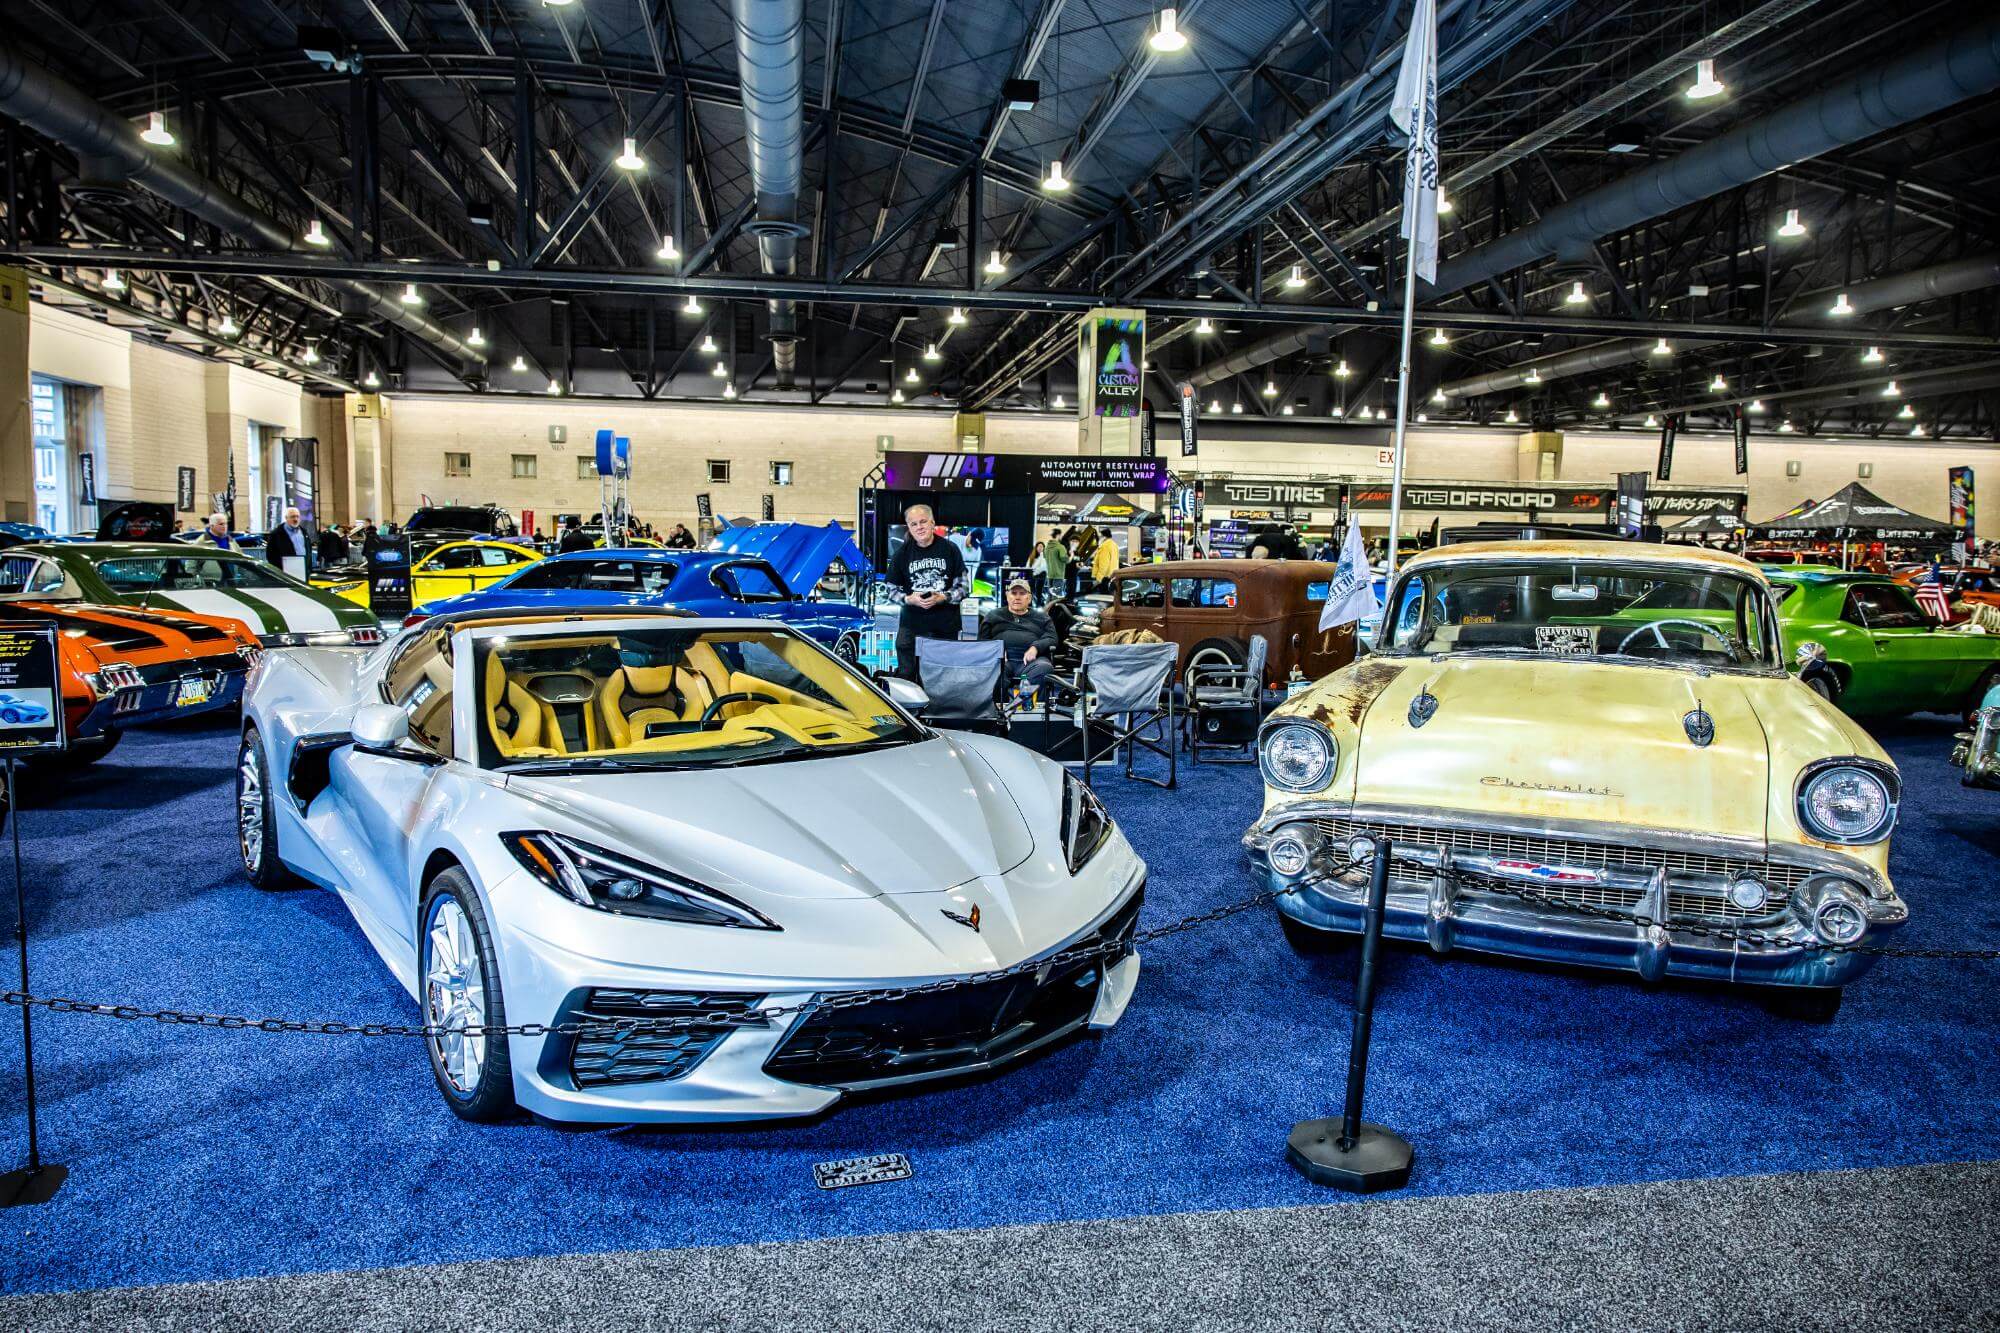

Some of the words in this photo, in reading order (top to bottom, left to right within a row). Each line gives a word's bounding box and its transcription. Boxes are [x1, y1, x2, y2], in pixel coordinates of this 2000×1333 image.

[1098, 373, 1139, 385] CUSTOM
[1098, 386, 1139, 396] ALLEY
[1379, 451, 1394, 463] EX
[1040, 461, 1101, 470] AUTOMOTIVE
[1106, 462, 1156, 470] RESTYLING
[1042, 471, 1078, 479] WINDOW
[1079, 471, 1096, 479] TINT
[1108, 471, 1131, 479] VINYL
[1133, 471, 1155, 479] WRAP
[1062, 480, 1084, 488] PAINT
[1086, 480, 1135, 489] PROTECTION
[1224, 484, 1272, 501] TIS
[1273, 486, 1325, 503] TIRES
[1406, 490, 1448, 505] TIS
[1449, 491, 1556, 508] OFFROAD
[1664, 497, 1697, 511] YEARS
[908, 558, 947, 574] GRAVEYARD
[1539, 627, 1588, 638] GRAVEYARD
[1480, 776, 1624, 797] Chevrolet
